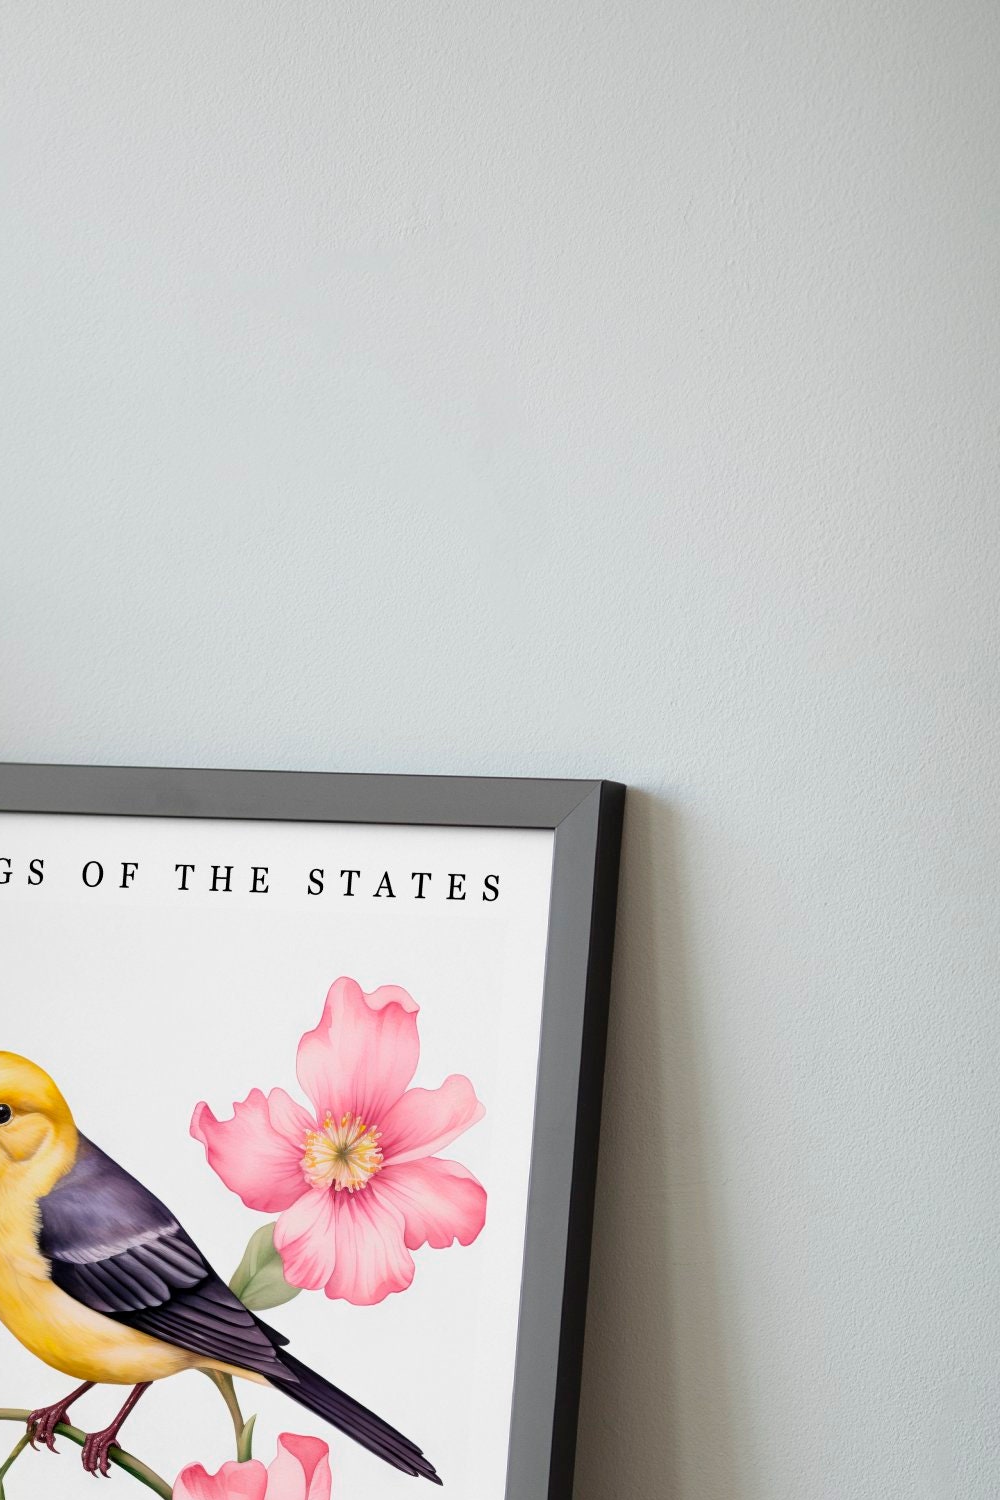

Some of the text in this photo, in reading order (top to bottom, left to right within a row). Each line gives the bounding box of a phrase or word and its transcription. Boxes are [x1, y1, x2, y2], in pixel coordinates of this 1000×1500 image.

[81, 860, 139, 889] OF
[174, 863, 269, 894] THE
[307, 868, 500, 902] STATES
